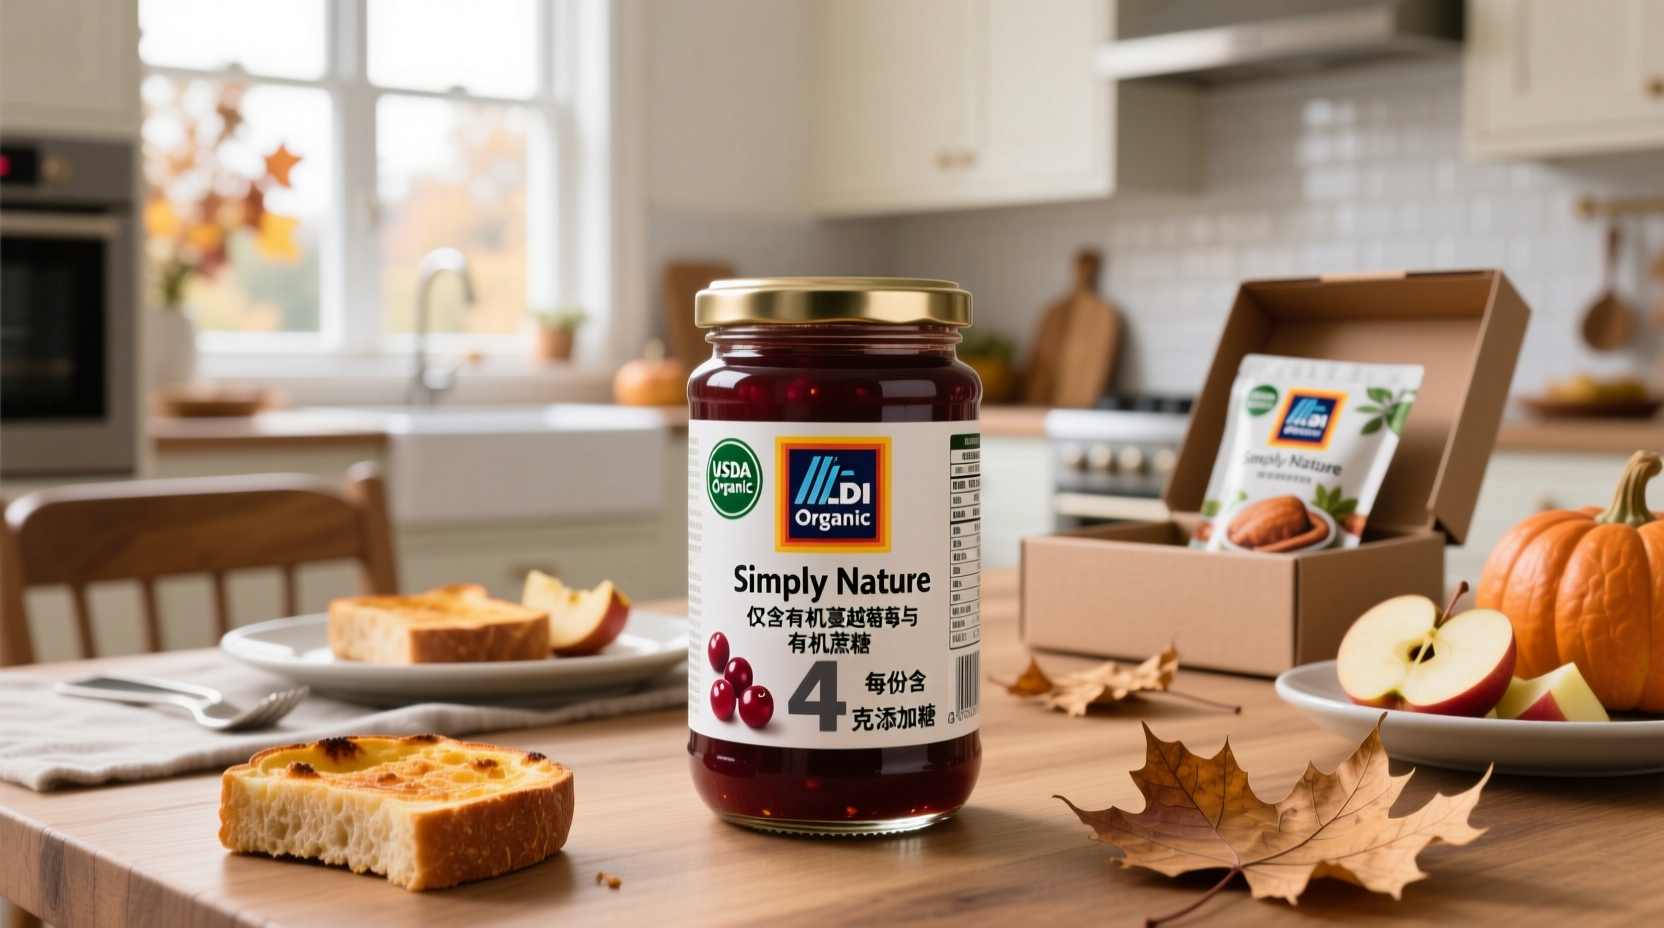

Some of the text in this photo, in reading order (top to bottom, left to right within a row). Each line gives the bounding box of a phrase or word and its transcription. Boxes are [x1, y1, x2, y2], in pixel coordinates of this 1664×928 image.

[712, 460, 752, 479] USDA
[1290, 454, 1343, 477] Nature
[795, 508, 871, 532] Organic
[733, 564, 931, 604] Simply Nature
[864, 669, 927, 696] 每份含
[787, 660, 847, 733] 4
[851, 702, 936, 732] 克添加糖
